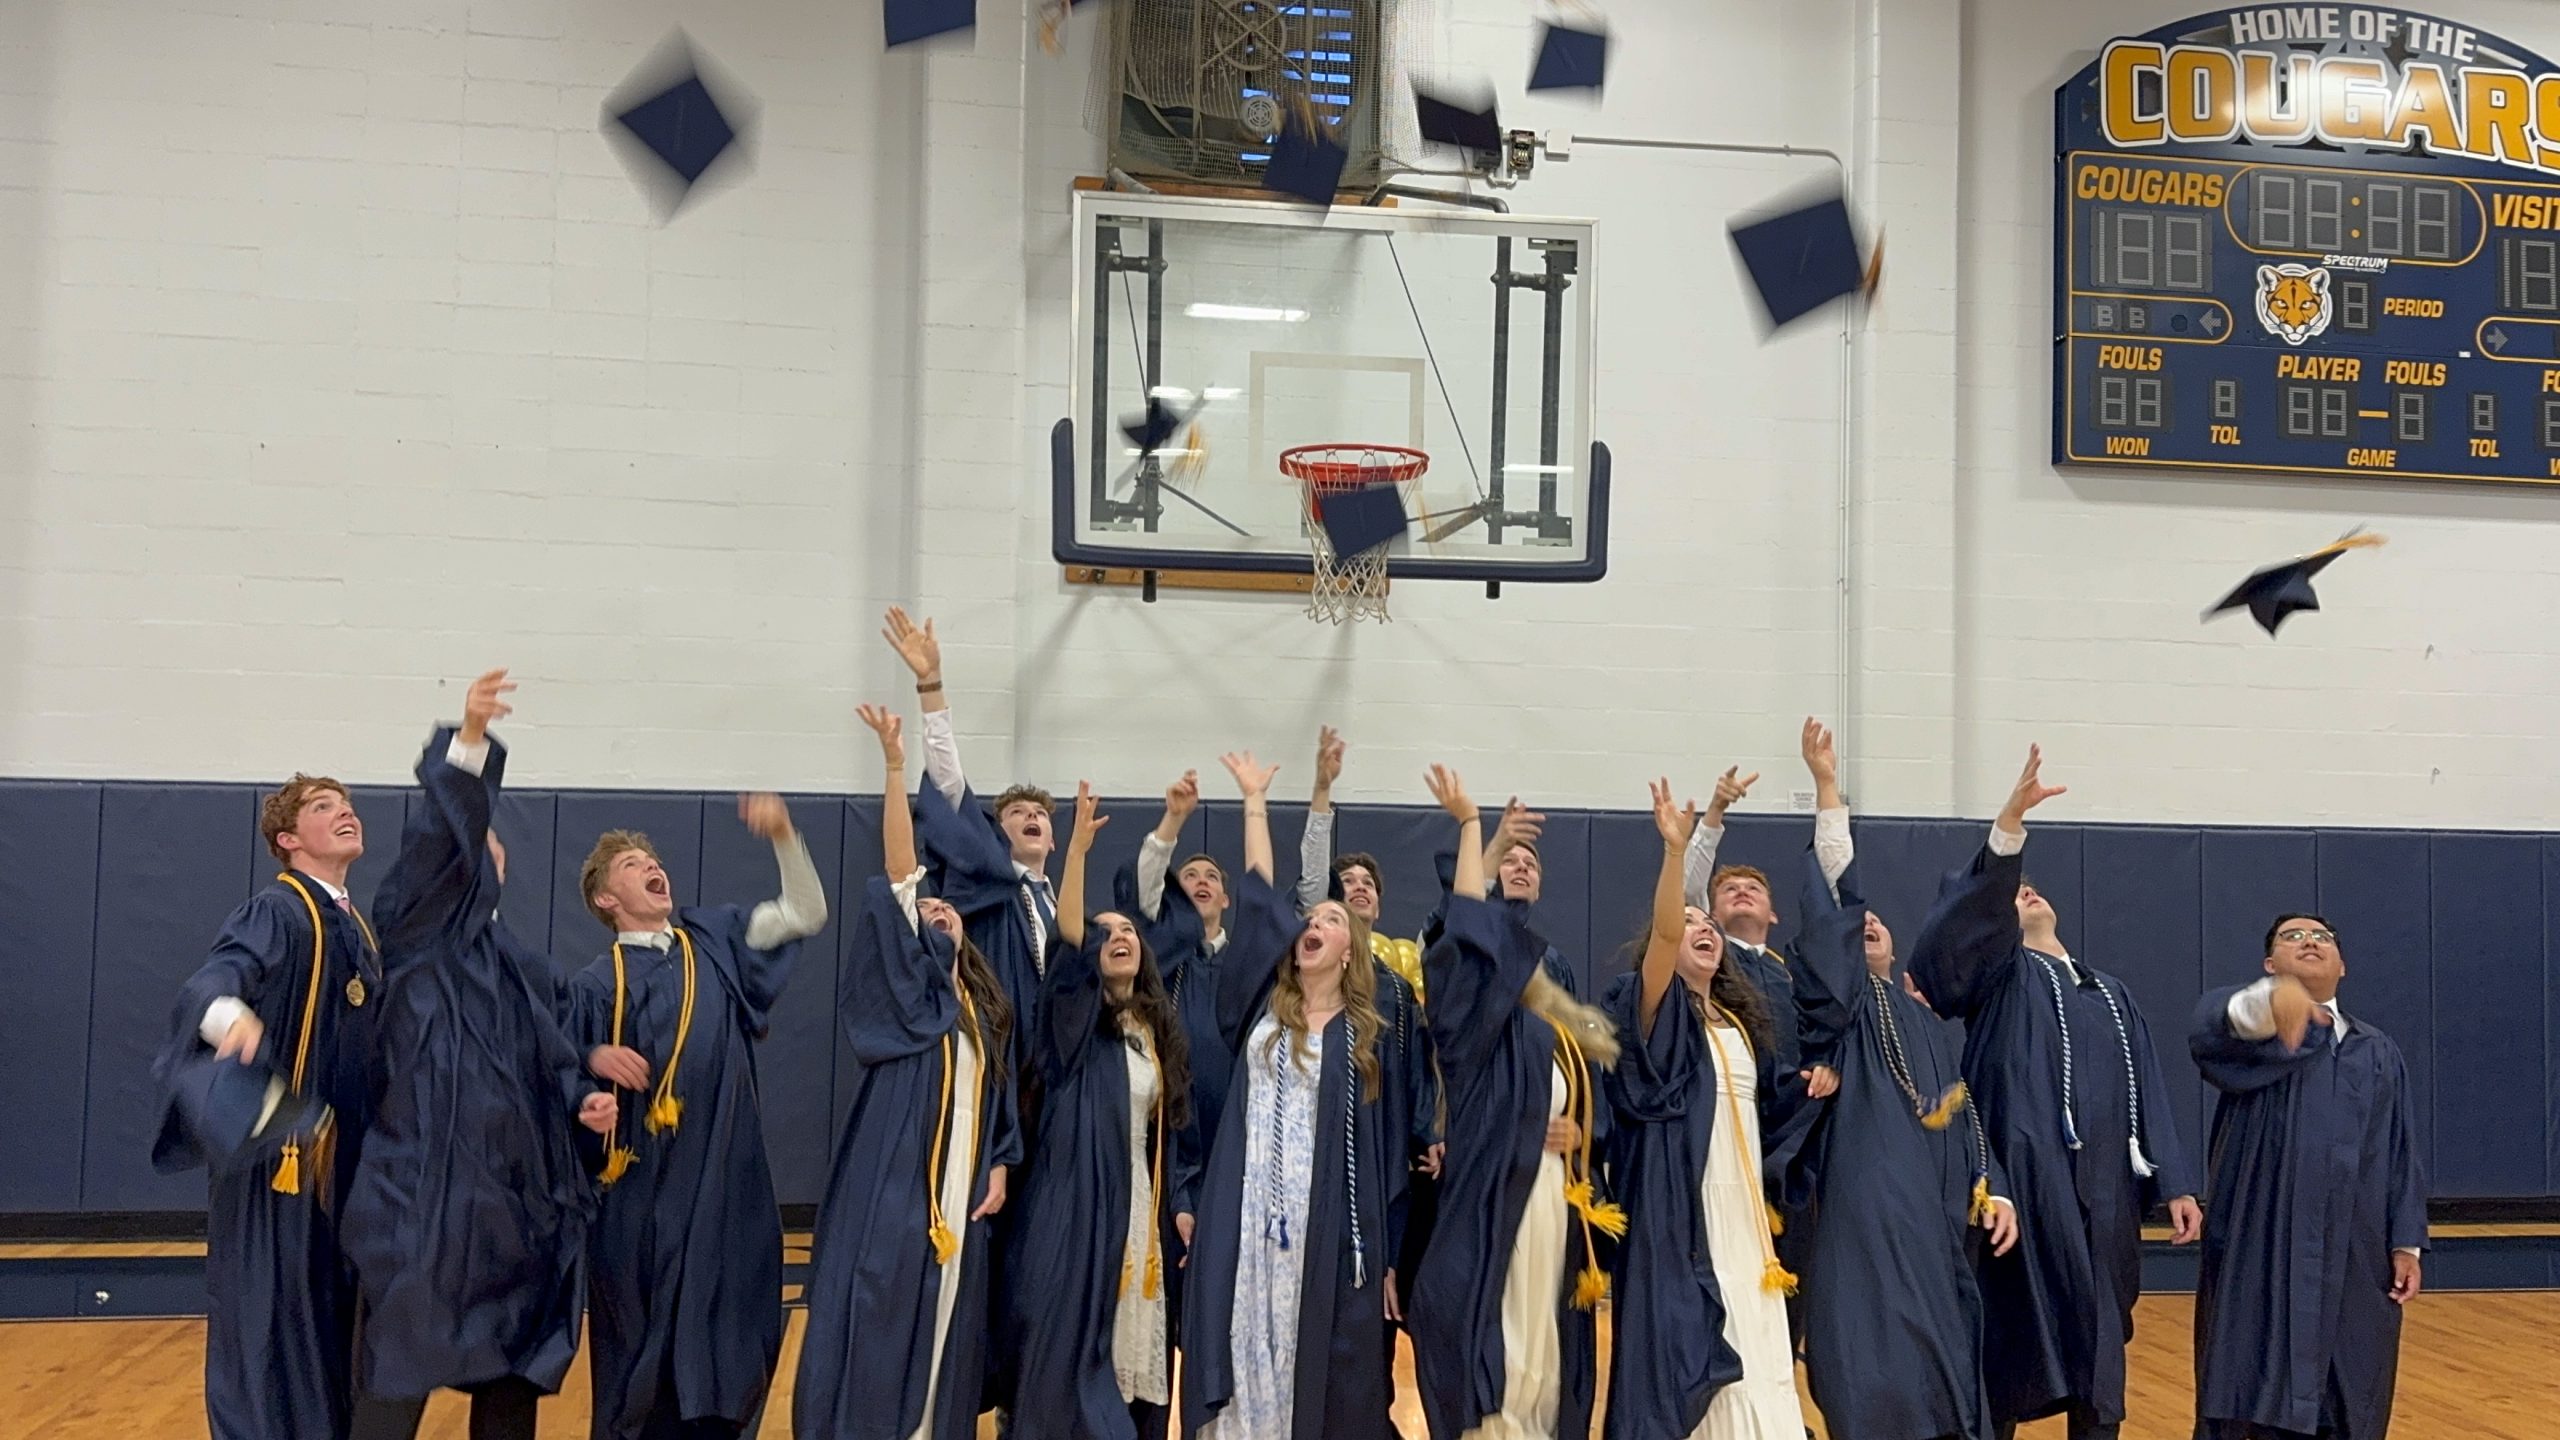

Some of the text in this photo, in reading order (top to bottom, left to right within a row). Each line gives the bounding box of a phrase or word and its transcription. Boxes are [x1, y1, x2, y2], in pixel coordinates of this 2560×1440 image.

[2230, 8, 2476, 62] HOME OF THE
[2077, 165, 2224, 208] COUGARS
[2322, 254, 2388, 269] SPECTRUM
[2098, 305, 2145, 329] B B
[2384, 298, 2444, 318] PERIOD
[2098, 345, 2162, 371] FOULS
[2277, 355, 2447, 386] PLAYER FOULS
[2210, 425, 2241, 445] TOL
[2106, 436, 2150, 456] WON
[2469, 438, 2500, 457] TOL
[2347, 448, 2397, 468] GAME
